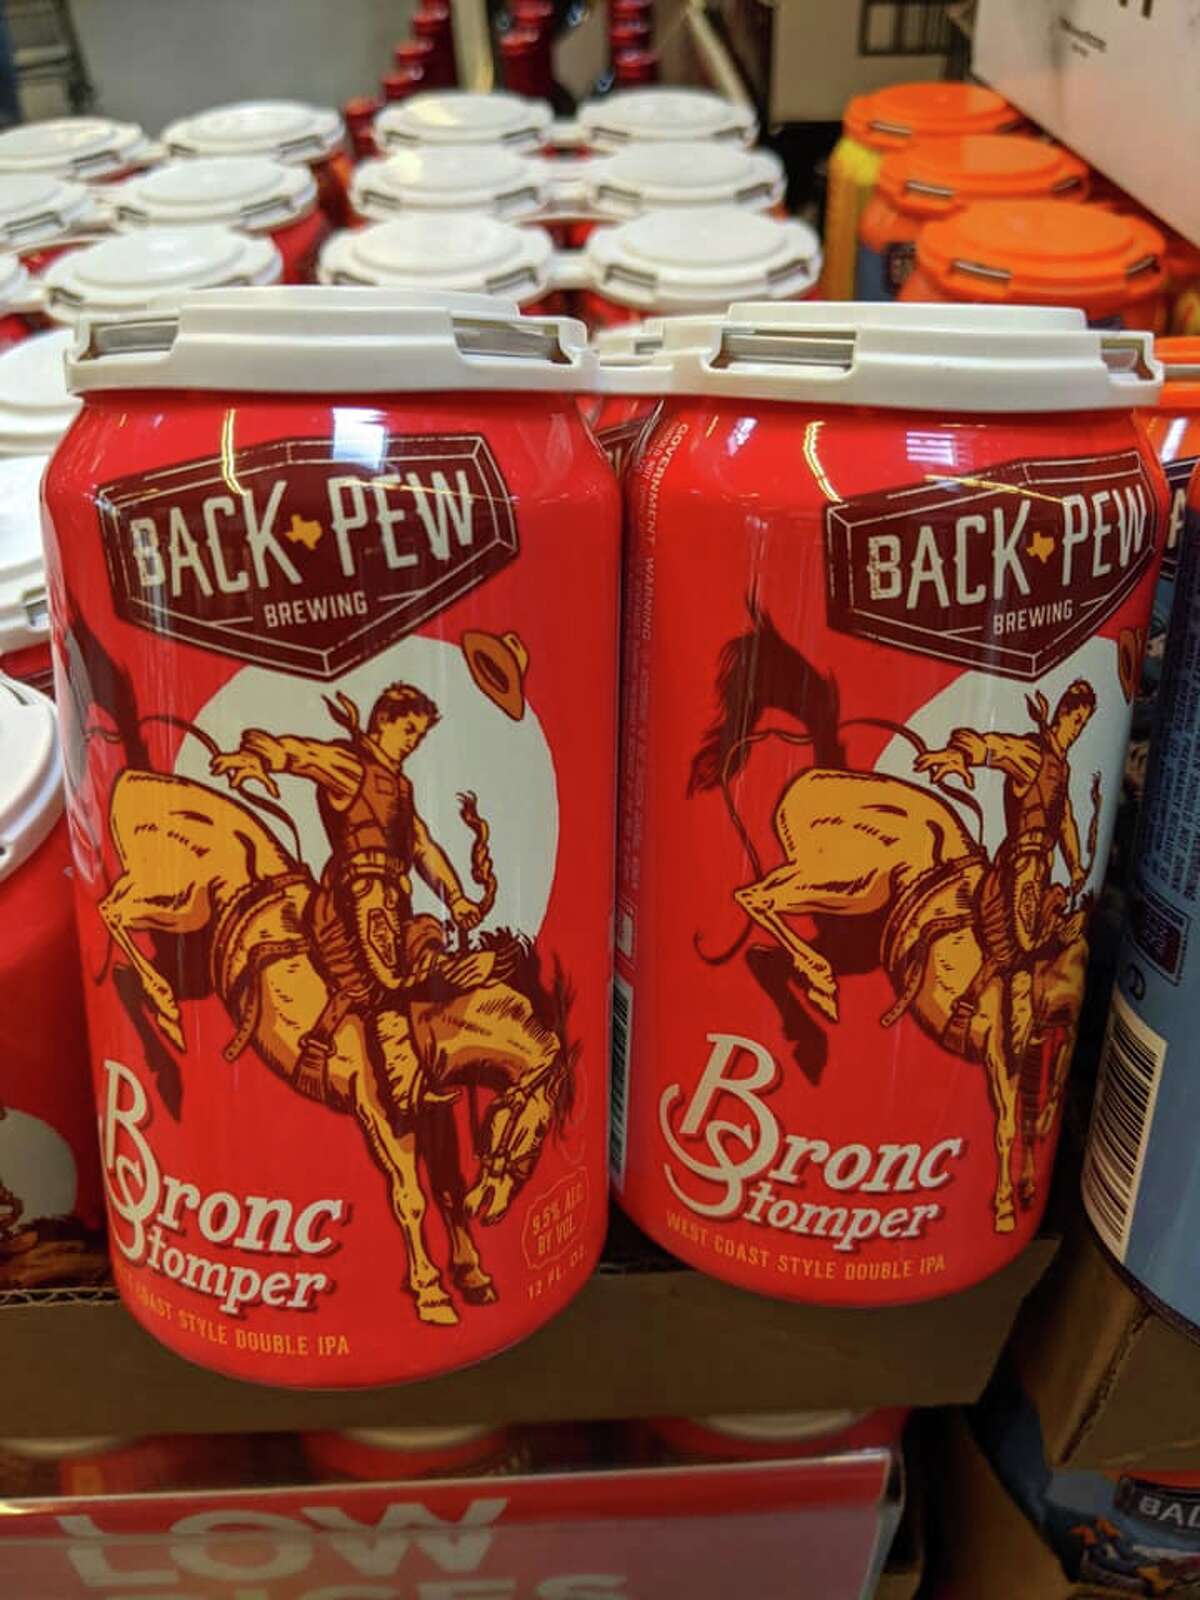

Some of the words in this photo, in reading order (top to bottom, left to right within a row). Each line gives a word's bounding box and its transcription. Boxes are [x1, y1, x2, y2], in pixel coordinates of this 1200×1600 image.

[130, 479, 302, 599] BACK
[326, 469, 474, 578] PEW
[649, 423, 688, 546] GOVERNMENT
[641, 558, 654, 641] WARNING
[867, 500, 1031, 610] BACK
[1061, 485, 1147, 586] PEW
[263, 591, 368, 629] BREWING
[992, 599, 1074, 636] BREWING
[103, 1059, 345, 1254] Bronc
[659, 1033, 963, 1194] Bronc
[114, 1154, 328, 1316] Stomper
[663, 1118, 939, 1253] Stomper
[665, 1209, 709, 1249] WEST
[714, 1234, 771, 1271] COAST
[777, 1254, 835, 1282] STYLE
[844, 1258, 912, 1282] DOUBLE
[919, 1254, 946, 1275] IPA
[179, 1311, 229, 1345] STYLE
[235, 1329, 309, 1355] DOUBLE
[318, 1334, 350, 1355] IPA
[57, 1498, 509, 1587] LOW
